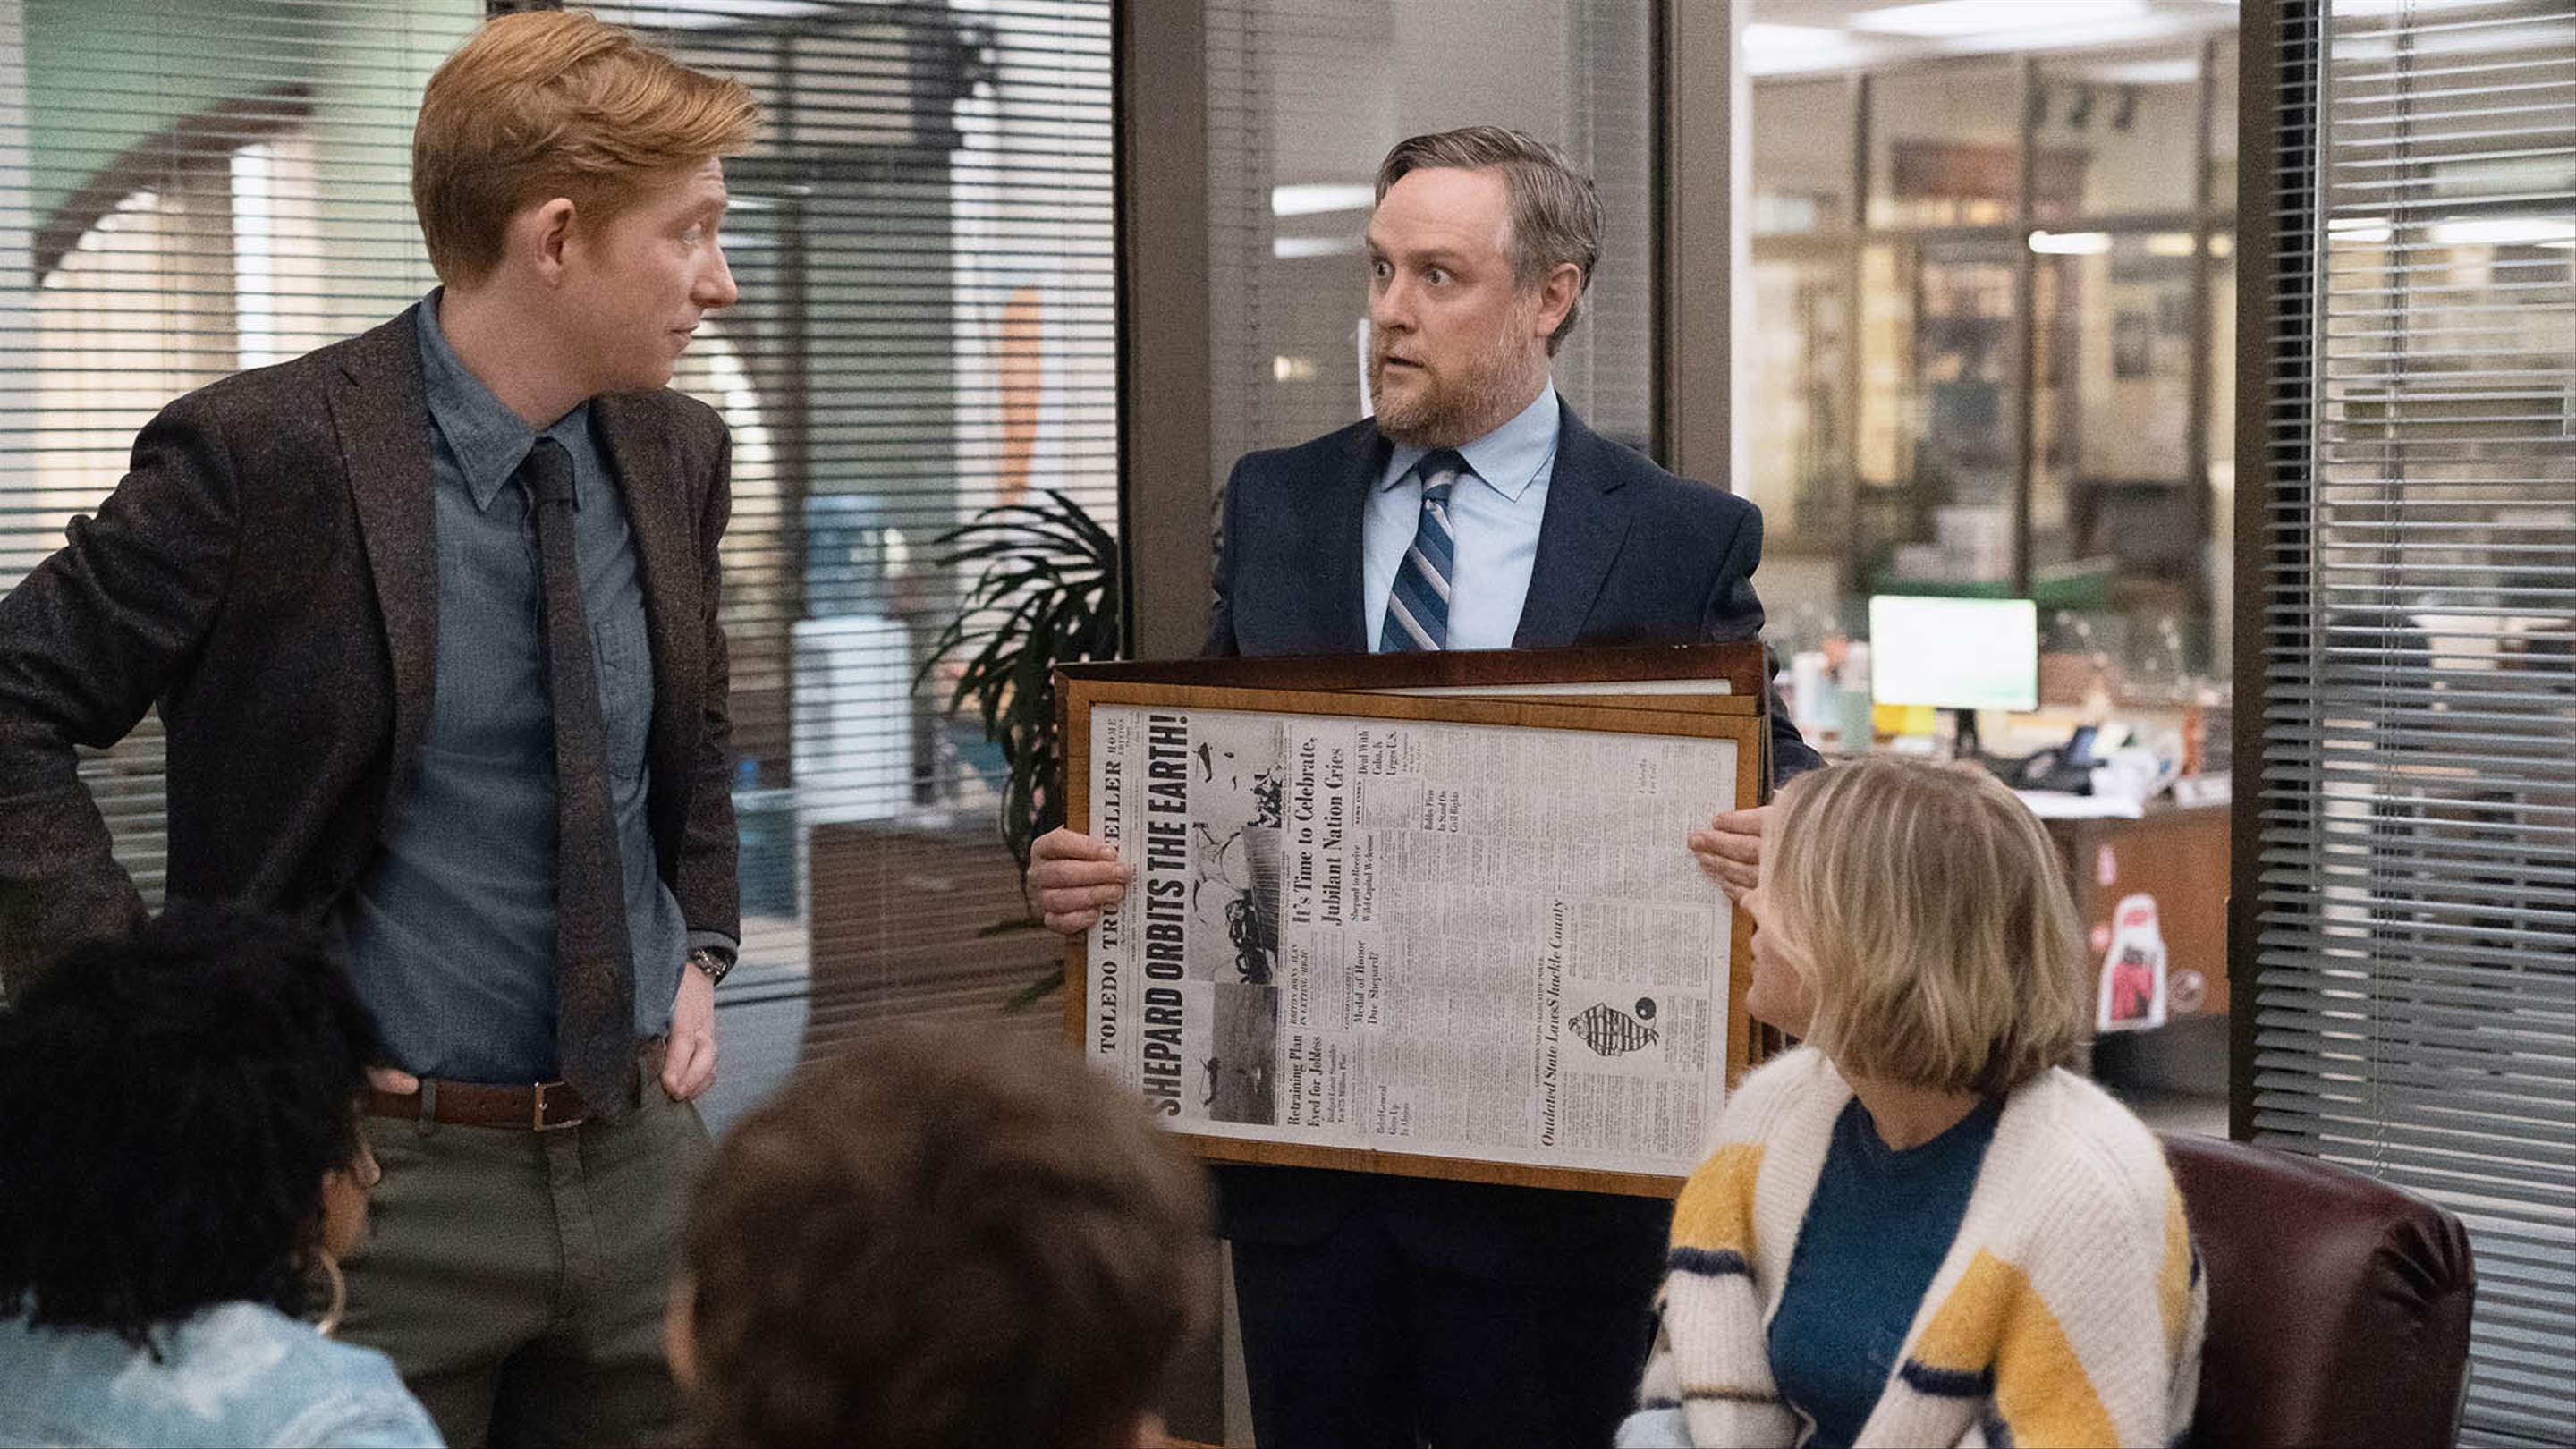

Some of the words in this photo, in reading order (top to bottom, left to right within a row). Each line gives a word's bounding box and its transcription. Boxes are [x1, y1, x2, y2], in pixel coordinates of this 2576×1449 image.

[1107, 717, 1117, 754] HOME
[1358, 730, 1368, 751] With
[1148, 715, 1189, 814] EARTH!
[1293, 737, 1317, 821] Celebrate,
[1324, 748, 1343, 789] Cries
[1358, 754, 1368, 775] Deal
[1296, 827, 1314, 844] to
[1322, 796, 1343, 850] Nation
[1147, 820, 1187, 872] THE
[1352, 844, 1360, 877] Receive
[1293, 852, 1313, 893] Time
[1352, 877, 1360, 886] to
[1363, 872, 1376, 902] Capital
[1320, 857, 1342, 926] Jubilant
[1351, 887, 1361, 921] Shepard
[1144, 878, 1186, 981] ORBITS
[1549, 898, 1568, 950] County
[1354, 940, 1365, 973] Honor
[1354, 976, 1365, 989] of
[1368, 952, 1382, 999] Shepard?
[1100, 961, 1117, 1054] TOLEDO
[1352, 993, 1365, 1023] Medal
[1367, 1004, 1377, 1025] Due
[1143, 987, 1182, 1117] SHEPARD
[1289, 1035, 1302, 1060] Plan
[1309, 1036, 1322, 1076] Jobless
[1542, 1046, 1559, 1081] State
[1288, 1063, 1306, 1125] Retraining
[1308, 1079, 1321, 1097] for
[1308, 1100, 1325, 1127] Eyed
[1540, 1082, 1556, 1147] Outdated
